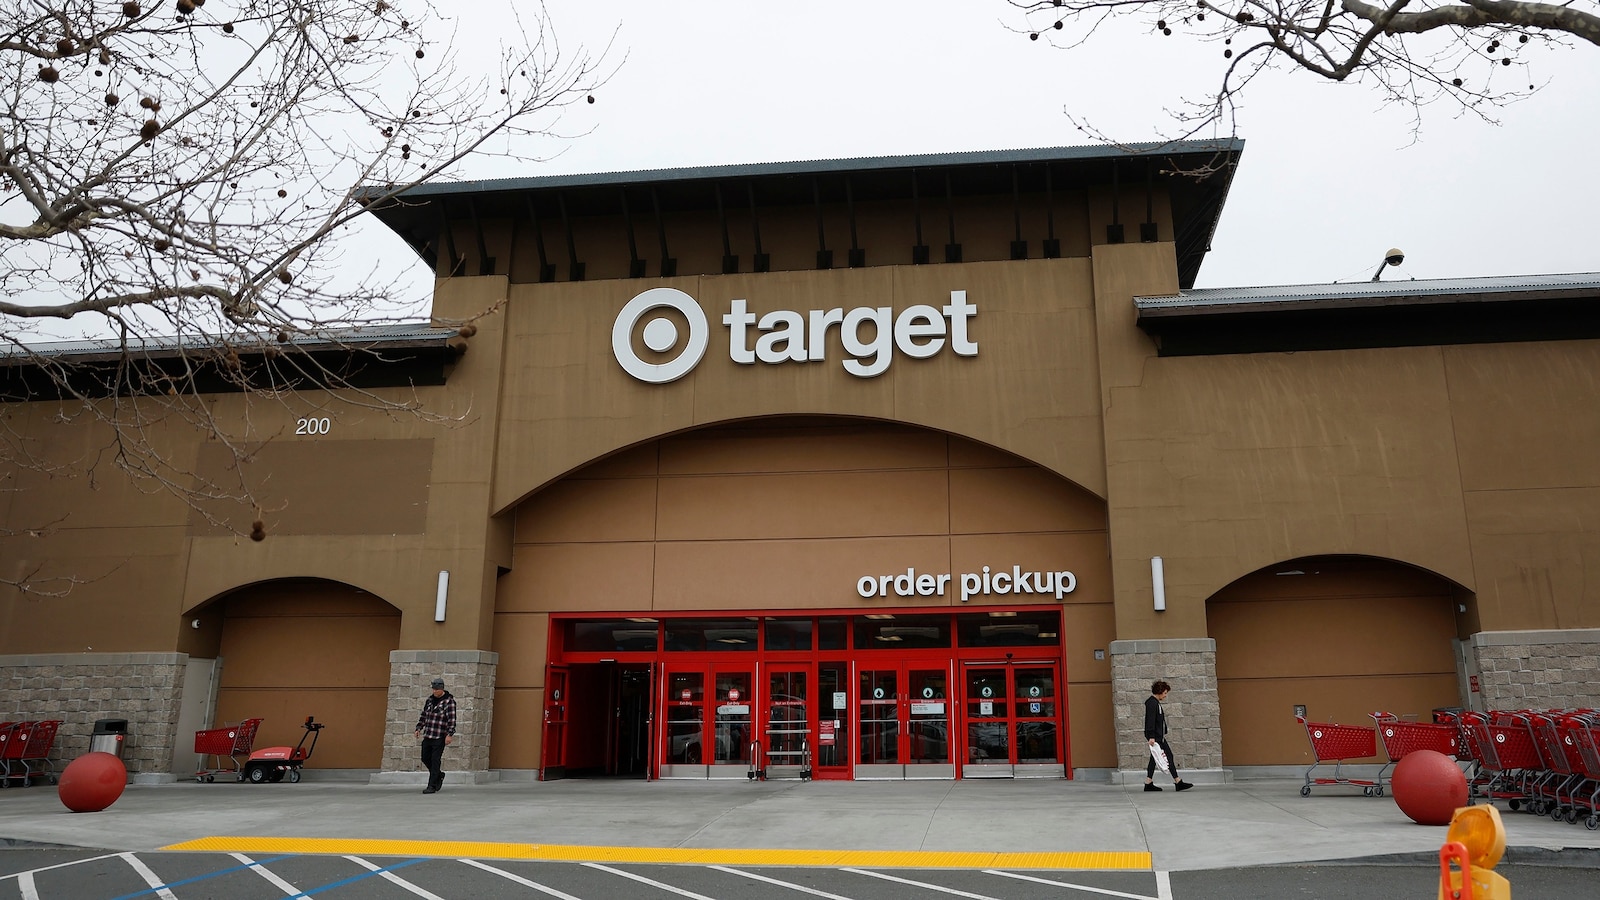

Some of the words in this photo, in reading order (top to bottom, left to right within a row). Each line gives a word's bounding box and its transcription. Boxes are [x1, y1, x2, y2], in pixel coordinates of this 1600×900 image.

[722, 290, 978, 378] target
[295, 417, 331, 435] 200
[856, 567, 951, 598] order
[960, 565, 1077, 602] pickup
